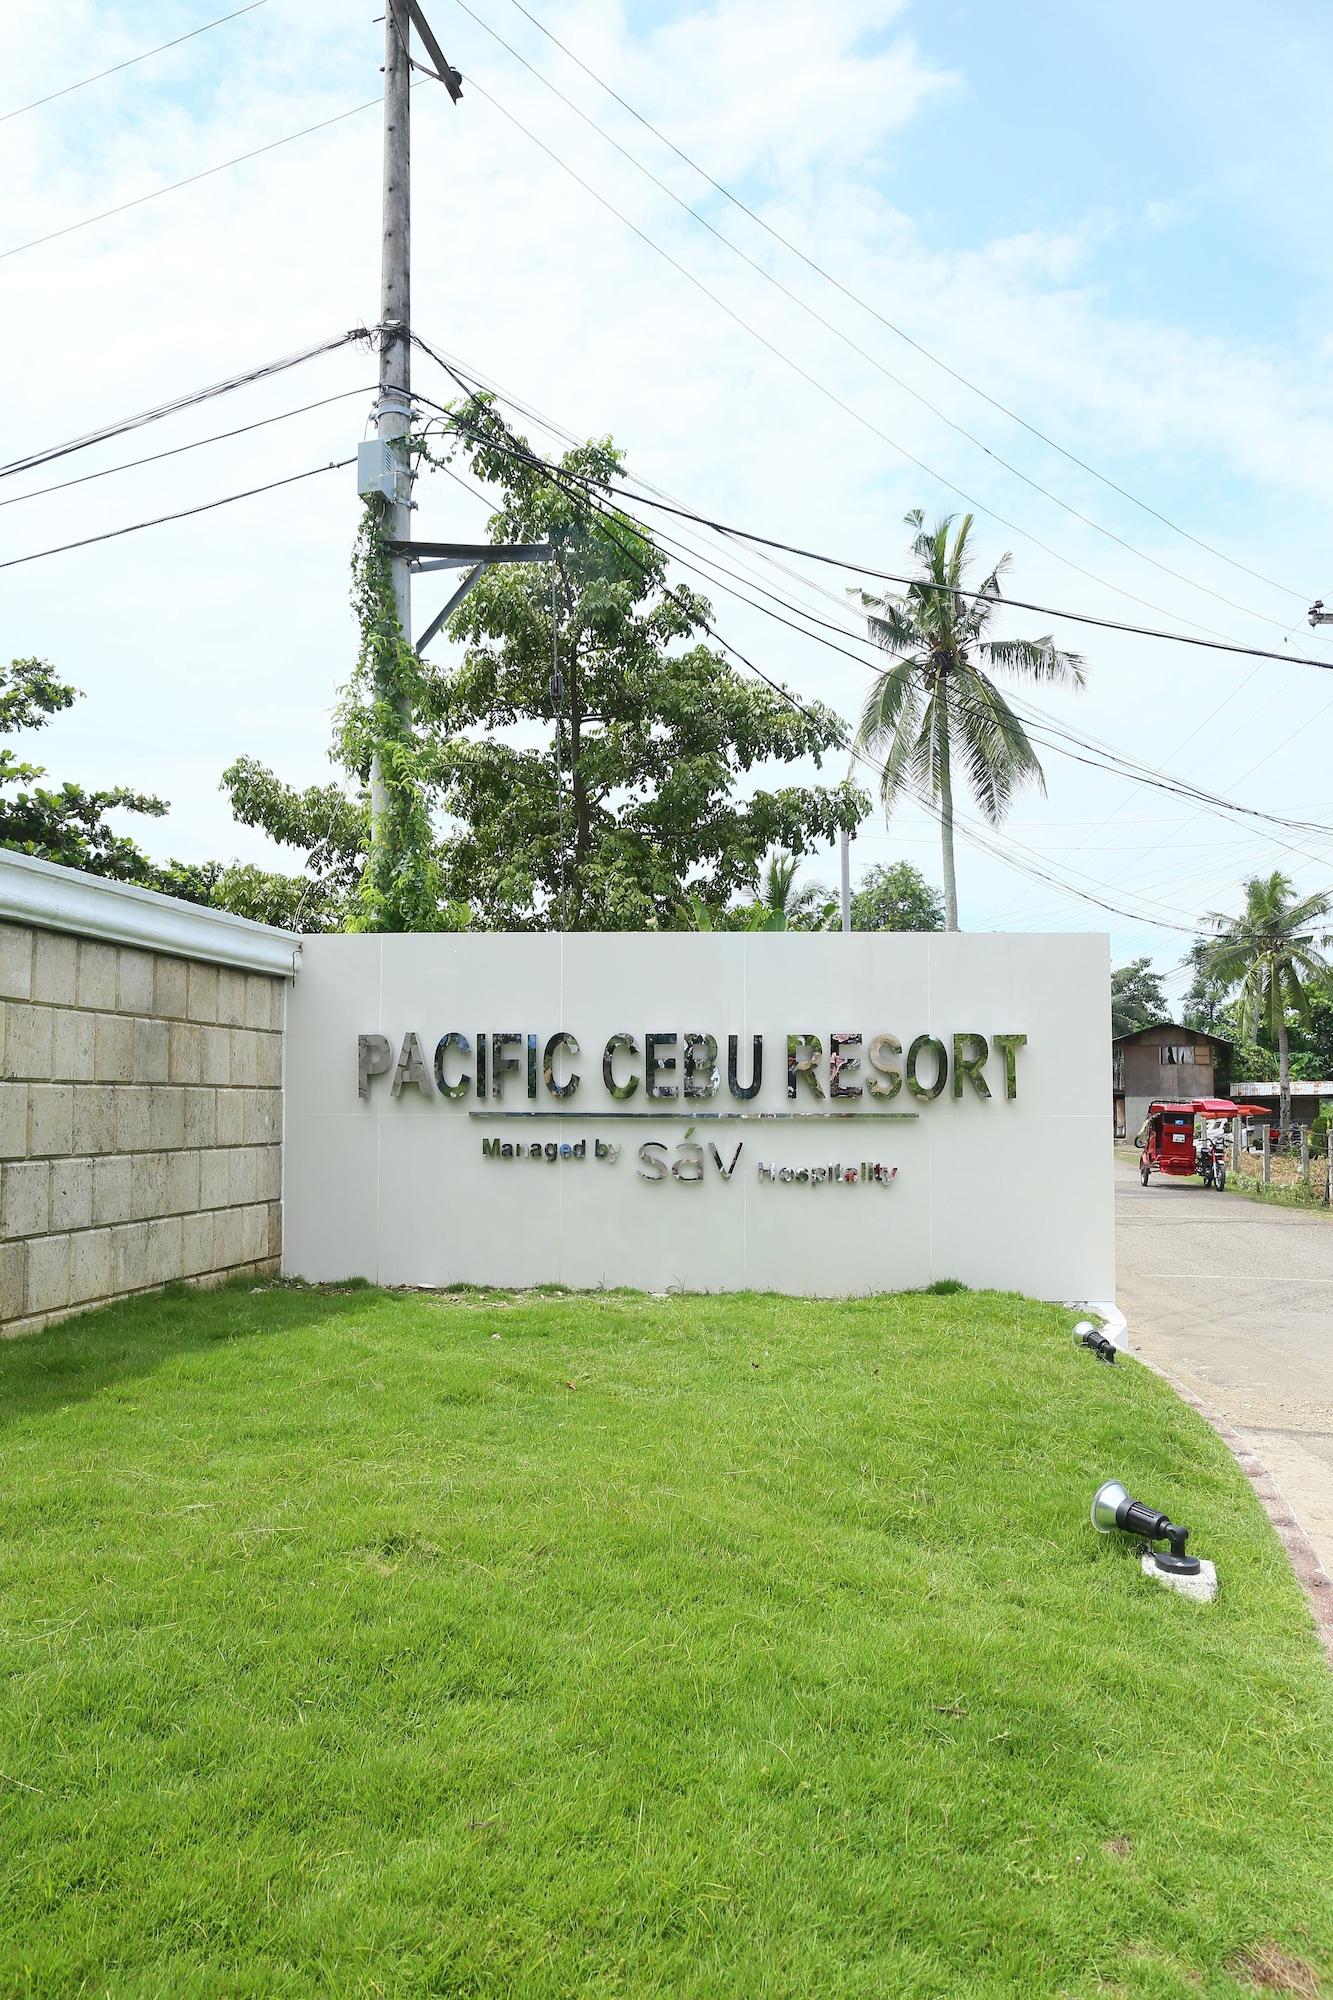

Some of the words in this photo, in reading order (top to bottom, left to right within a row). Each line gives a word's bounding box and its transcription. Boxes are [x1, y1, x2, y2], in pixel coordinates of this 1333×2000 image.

[357, 1032, 581, 1099] PACIFIC
[602, 1032, 763, 1100] CEBU
[786, 1033, 1028, 1100] RESORT
[482, 1138, 586, 1162] Managed
[595, 1139, 621, 1164] by
[757, 1161, 898, 1187] Hospitality
